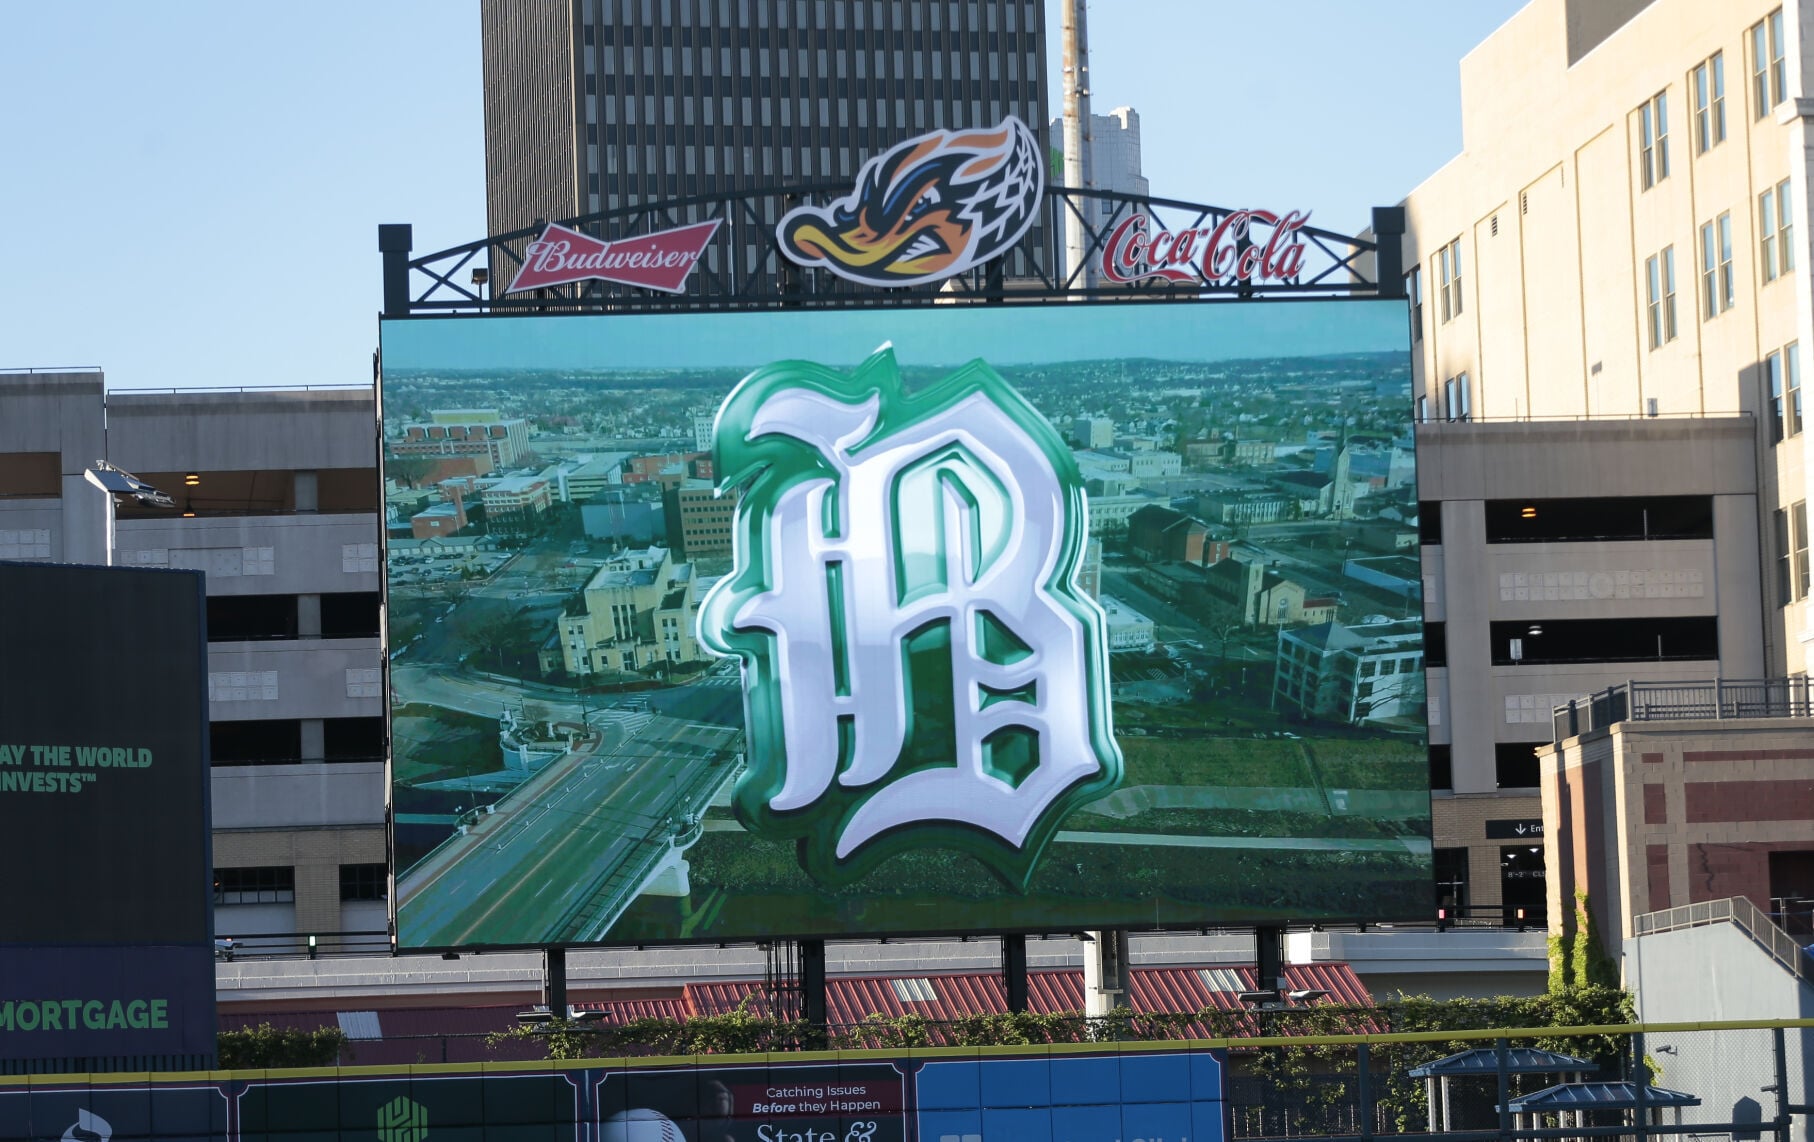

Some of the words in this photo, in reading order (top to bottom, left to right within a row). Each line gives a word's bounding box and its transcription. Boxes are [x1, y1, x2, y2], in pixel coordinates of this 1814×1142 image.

[526, 240, 698, 272] Budweiser
[1102, 209, 1312, 283] Coca-Cola
[30, 745, 71, 766] THE
[76, 746, 153, 768] WORLD
[766, 1086, 823, 1099] Catching
[827, 1085, 866, 1096] Issues
[752, 1102, 796, 1113] Before
[799, 1101, 827, 1114] they
[830, 1100, 880, 1113] Happen
